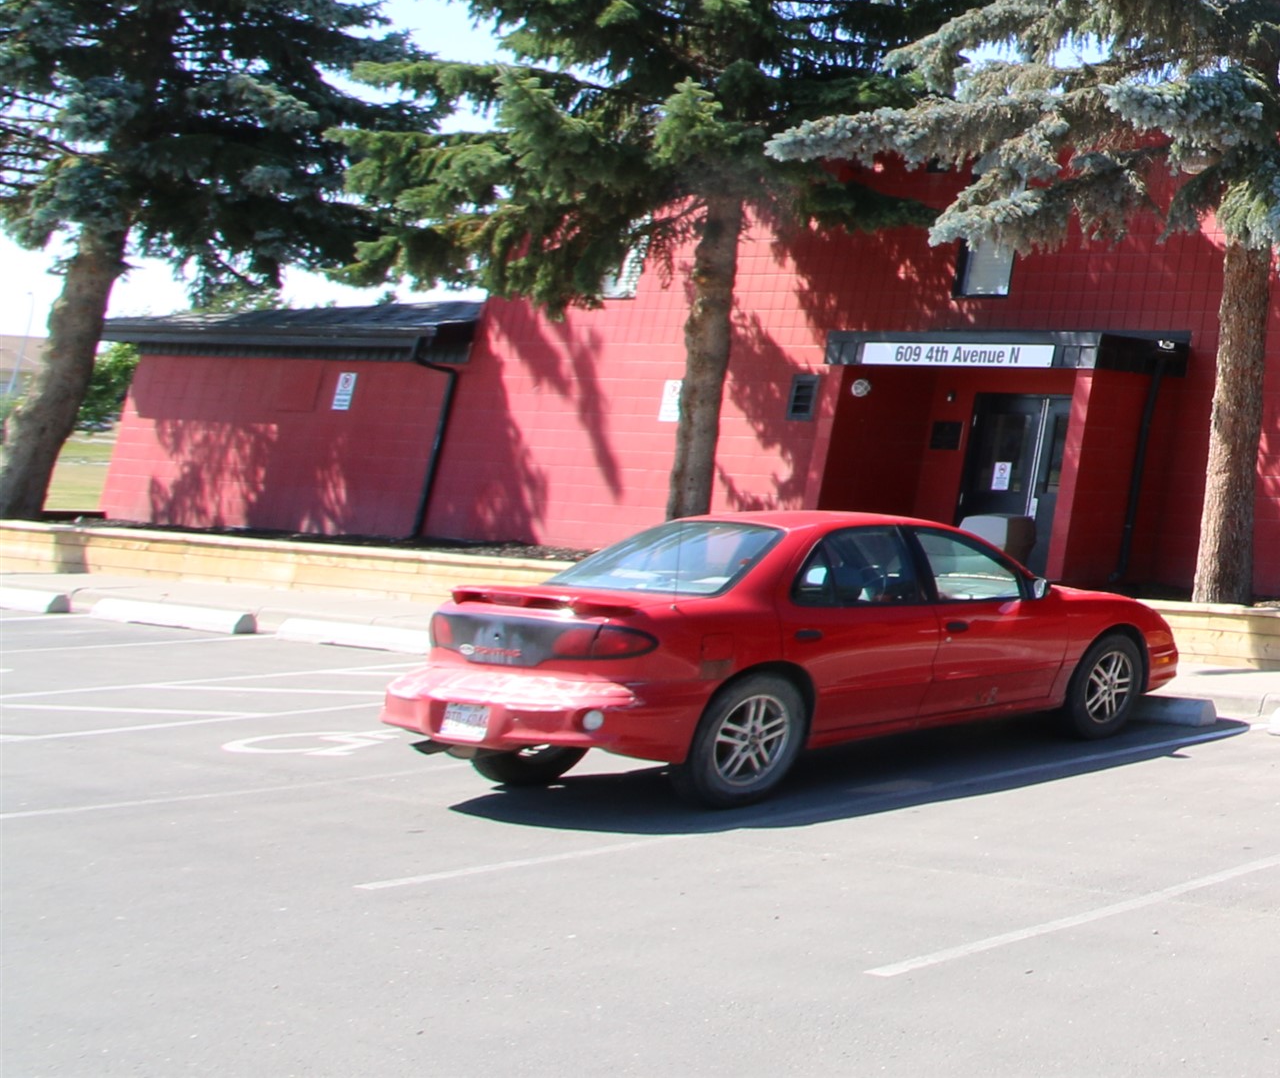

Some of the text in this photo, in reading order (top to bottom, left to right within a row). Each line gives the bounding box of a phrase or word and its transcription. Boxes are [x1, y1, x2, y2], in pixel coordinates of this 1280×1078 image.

[895, 345, 1020, 364] 609 4th Avenue N
